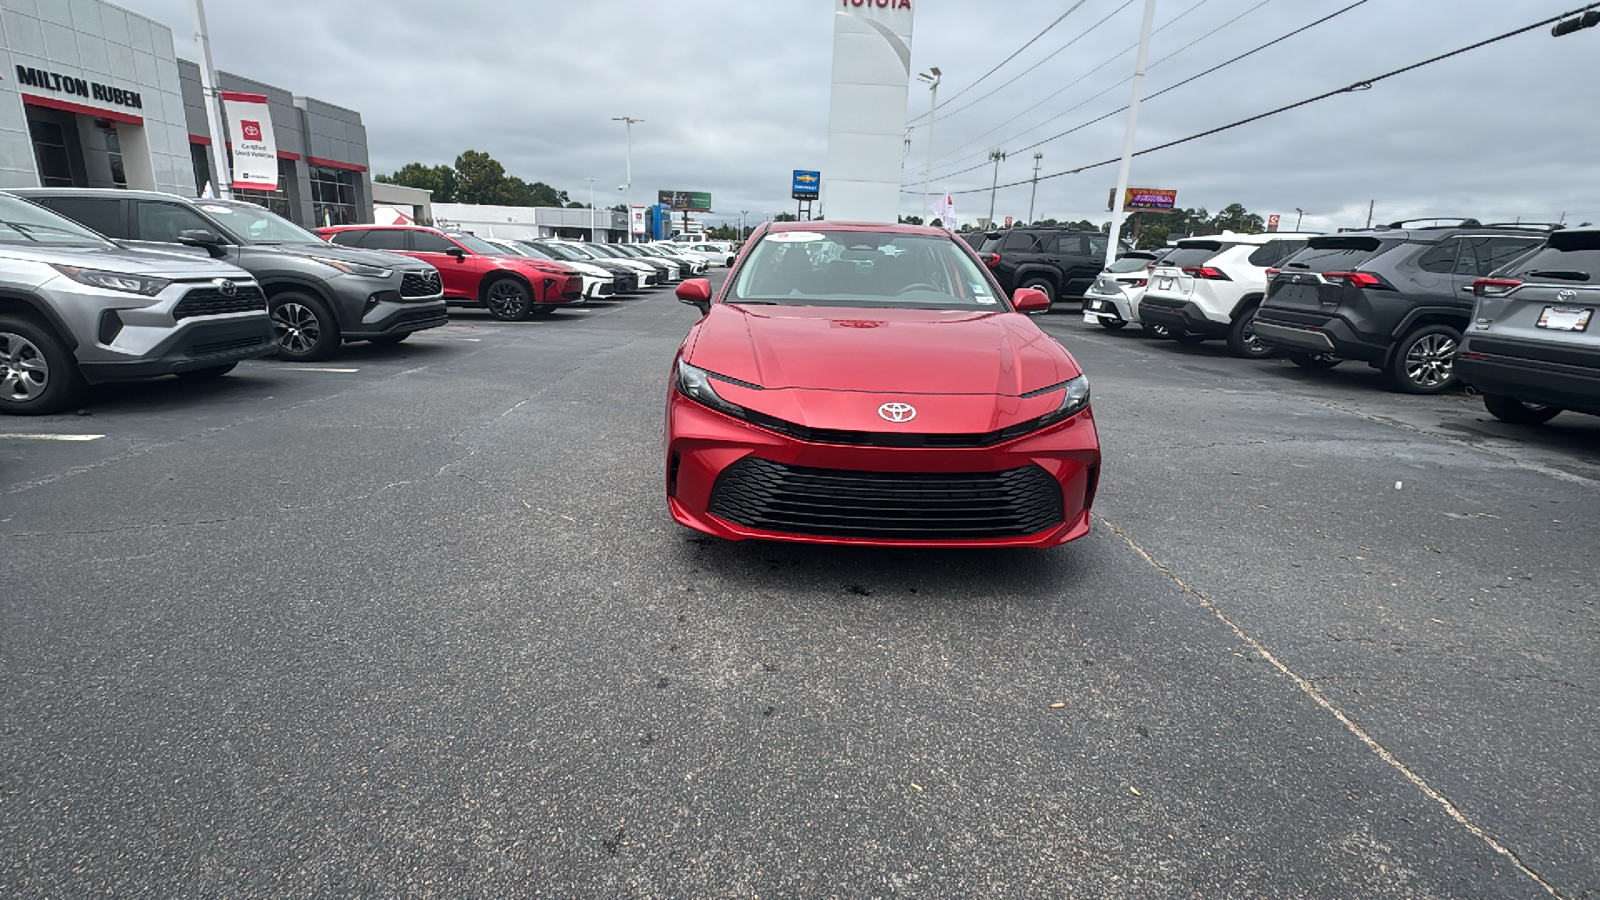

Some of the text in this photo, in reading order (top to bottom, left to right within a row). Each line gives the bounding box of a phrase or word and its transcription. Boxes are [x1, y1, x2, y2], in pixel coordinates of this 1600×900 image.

[16, 65, 143, 109] MILTON RUBEN
[241, 143, 267, 151] Certified
[235, 149, 274, 159] Used Vehicles
